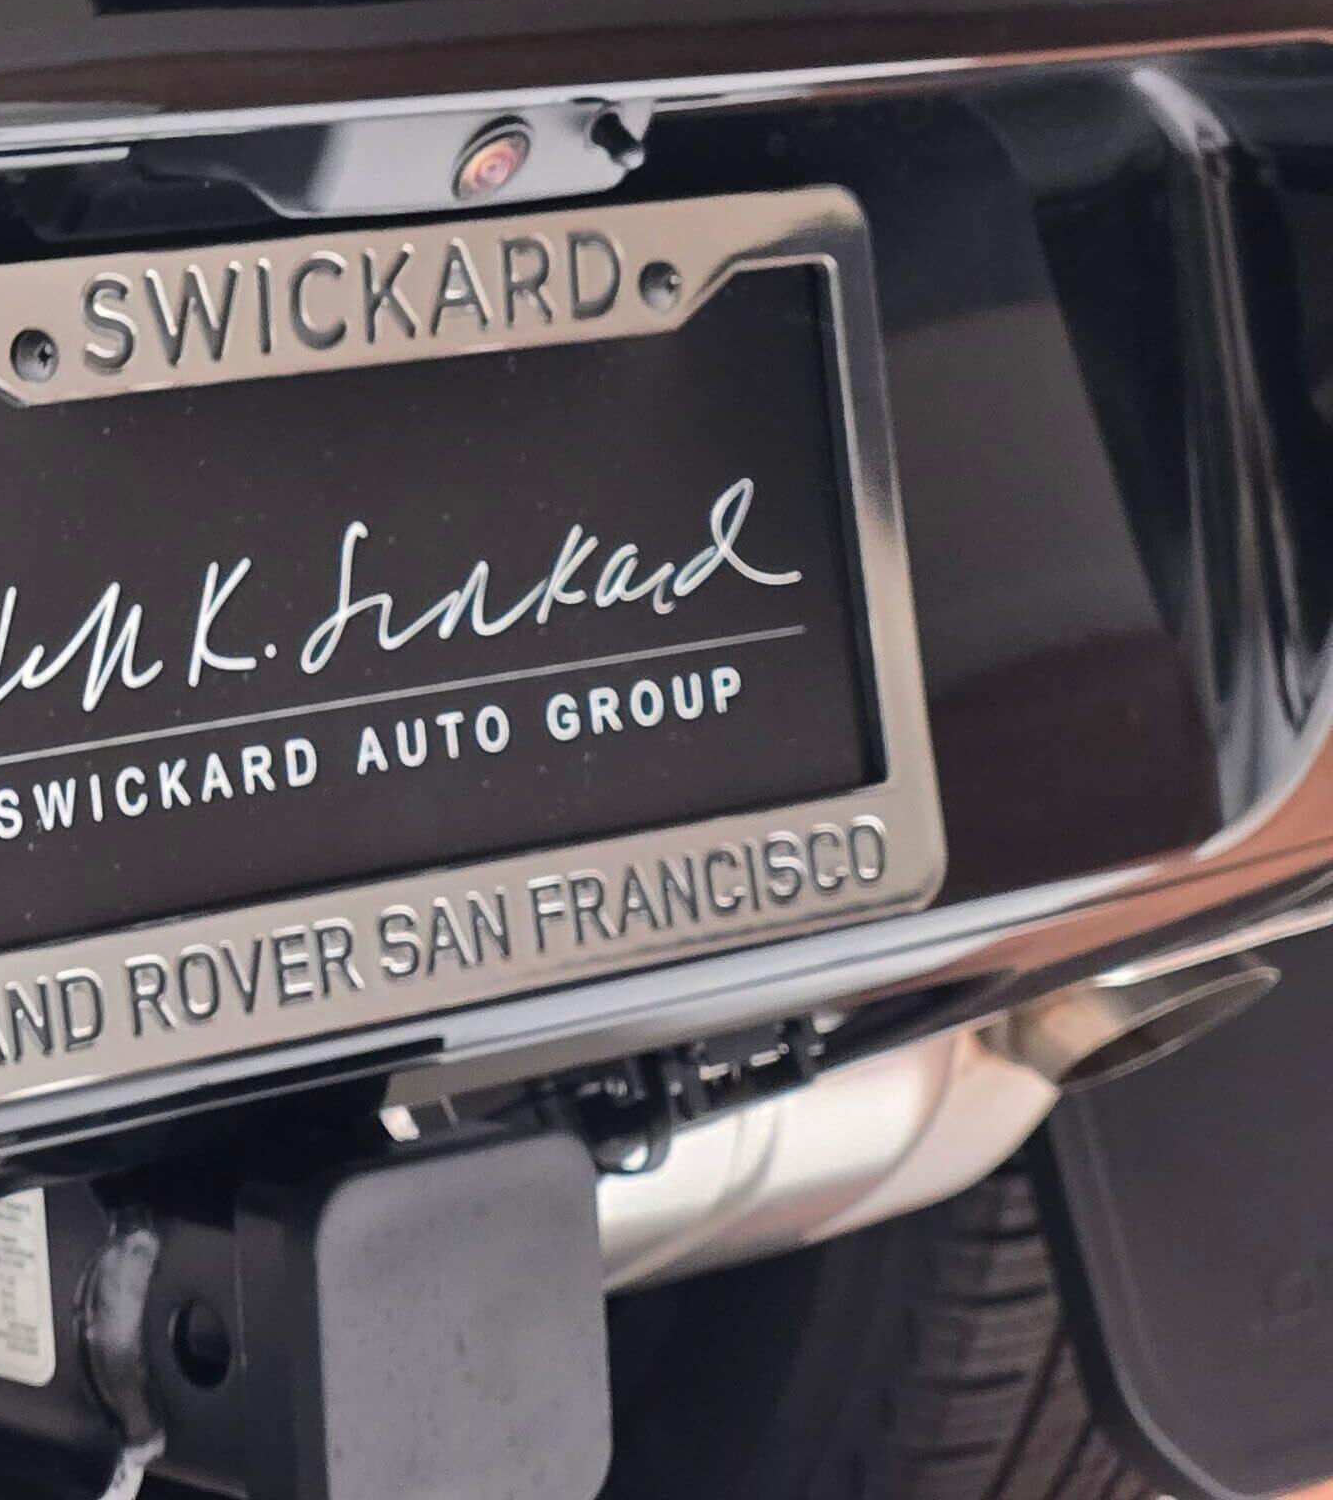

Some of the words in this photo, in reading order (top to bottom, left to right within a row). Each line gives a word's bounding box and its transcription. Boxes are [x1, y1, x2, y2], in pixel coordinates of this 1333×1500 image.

[81, 228, 627, 376] SWICKARD
[355, 704, 511, 776] AUTO
[545, 666, 743, 742] GROUP
[123, 915, 367, 1038] ROVER
[378, 884, 512, 979] SAN
[526, 812, 888, 955] FRANCISCO
